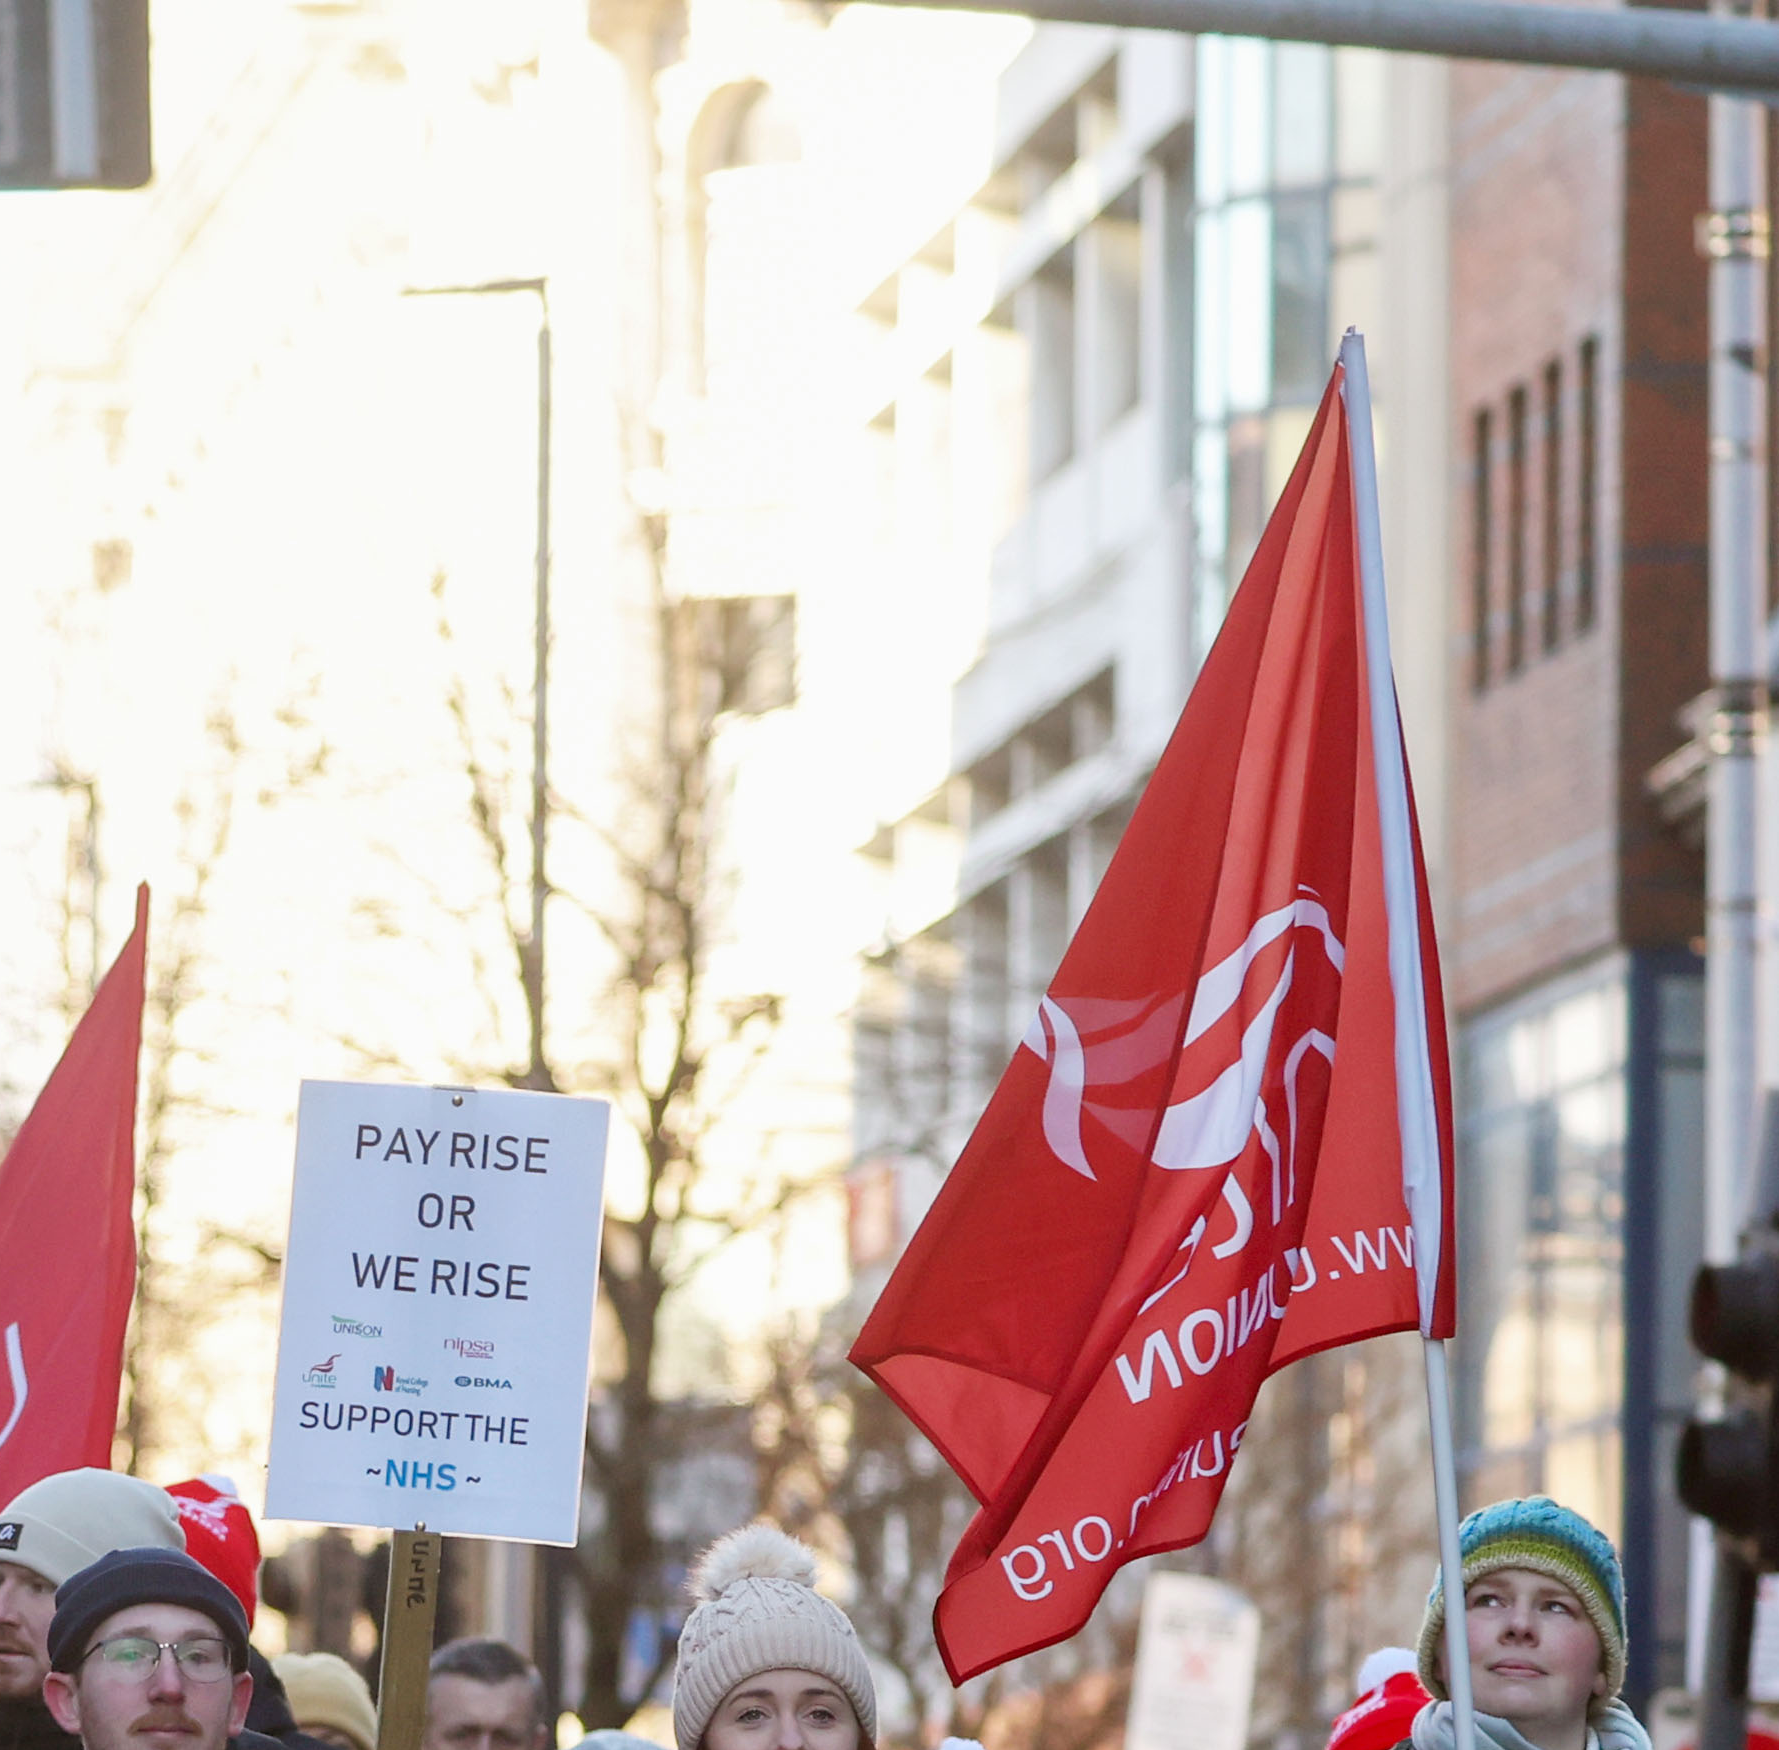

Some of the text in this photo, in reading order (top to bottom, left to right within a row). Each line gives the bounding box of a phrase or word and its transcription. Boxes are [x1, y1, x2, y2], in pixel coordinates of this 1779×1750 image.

[355, 1124, 551, 1174] PAY RISE
[417, 1192, 476, 1231] OR
[352, 1252, 532, 1301] WE RISE
[332, 1323, 383, 1337] UNISON
[444, 1337, 494, 1358] nipsa
[473, 1377, 513, 1390] BMA
[299, 1401, 530, 1446] SUPPORT THE
